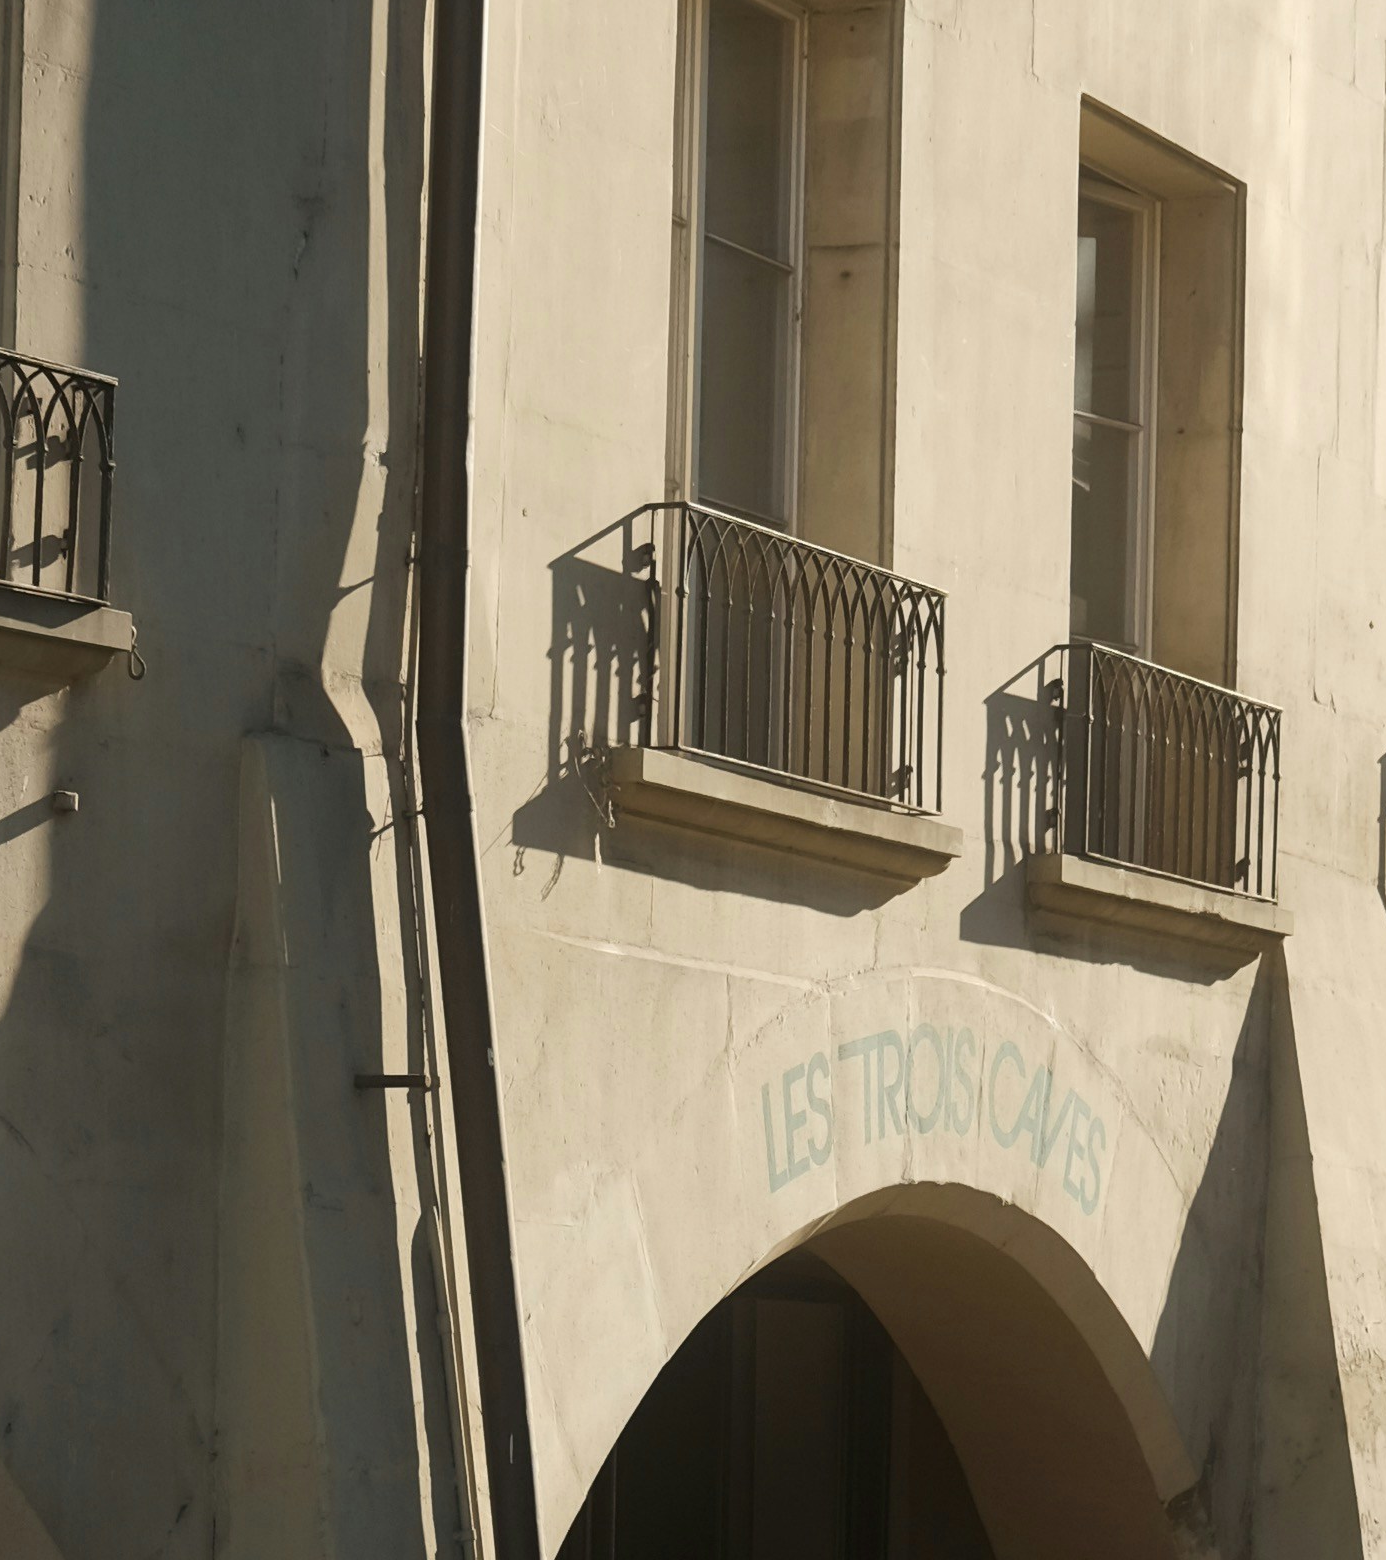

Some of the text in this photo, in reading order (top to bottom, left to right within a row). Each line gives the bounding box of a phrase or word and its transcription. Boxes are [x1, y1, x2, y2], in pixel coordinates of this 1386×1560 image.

[762, 1022, 1106, 1216] LES TROIS CAVES
